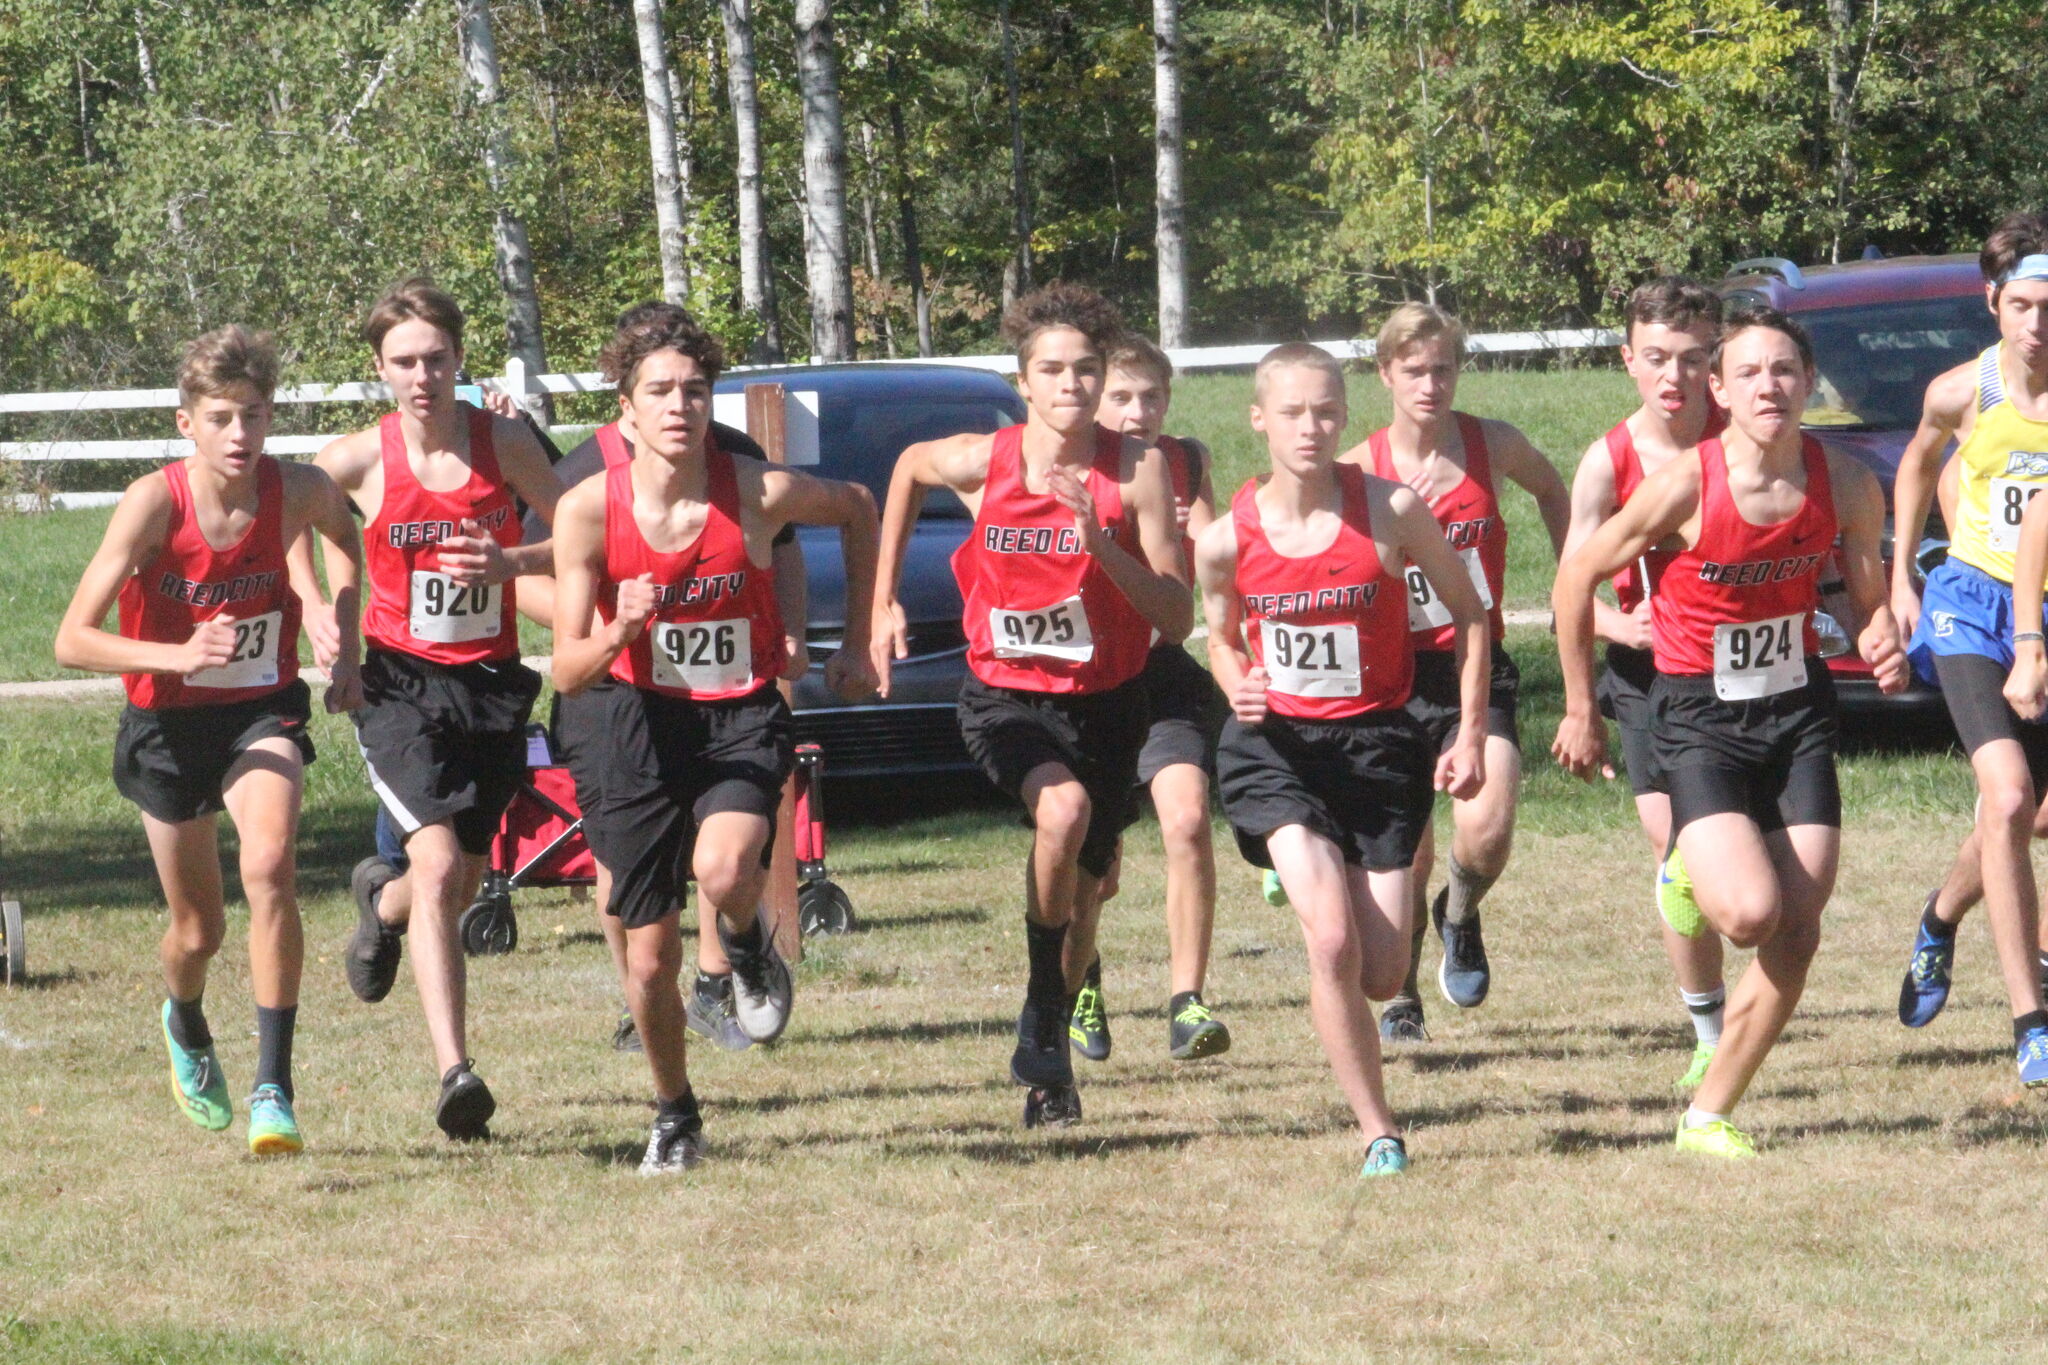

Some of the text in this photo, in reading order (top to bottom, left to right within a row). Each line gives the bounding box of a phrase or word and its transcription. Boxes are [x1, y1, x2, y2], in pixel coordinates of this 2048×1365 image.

[2004, 486, 2044, 526] 8
[389, 521, 454, 549] REED
[985, 525, 1054, 555] REED
[680, 571, 745, 605] CITY
[1698, 550, 1825, 587] REED CIT
[159, 570, 281, 608] REED CITY
[424, 577, 492, 617] 920
[1316, 581, 1380, 612] CITY
[228, 619, 268, 664] 23
[1003, 605, 1075, 646] 925
[1730, 619, 1792, 671] 924
[665, 625, 735, 667] 926
[1274, 627, 1342, 671] 921
